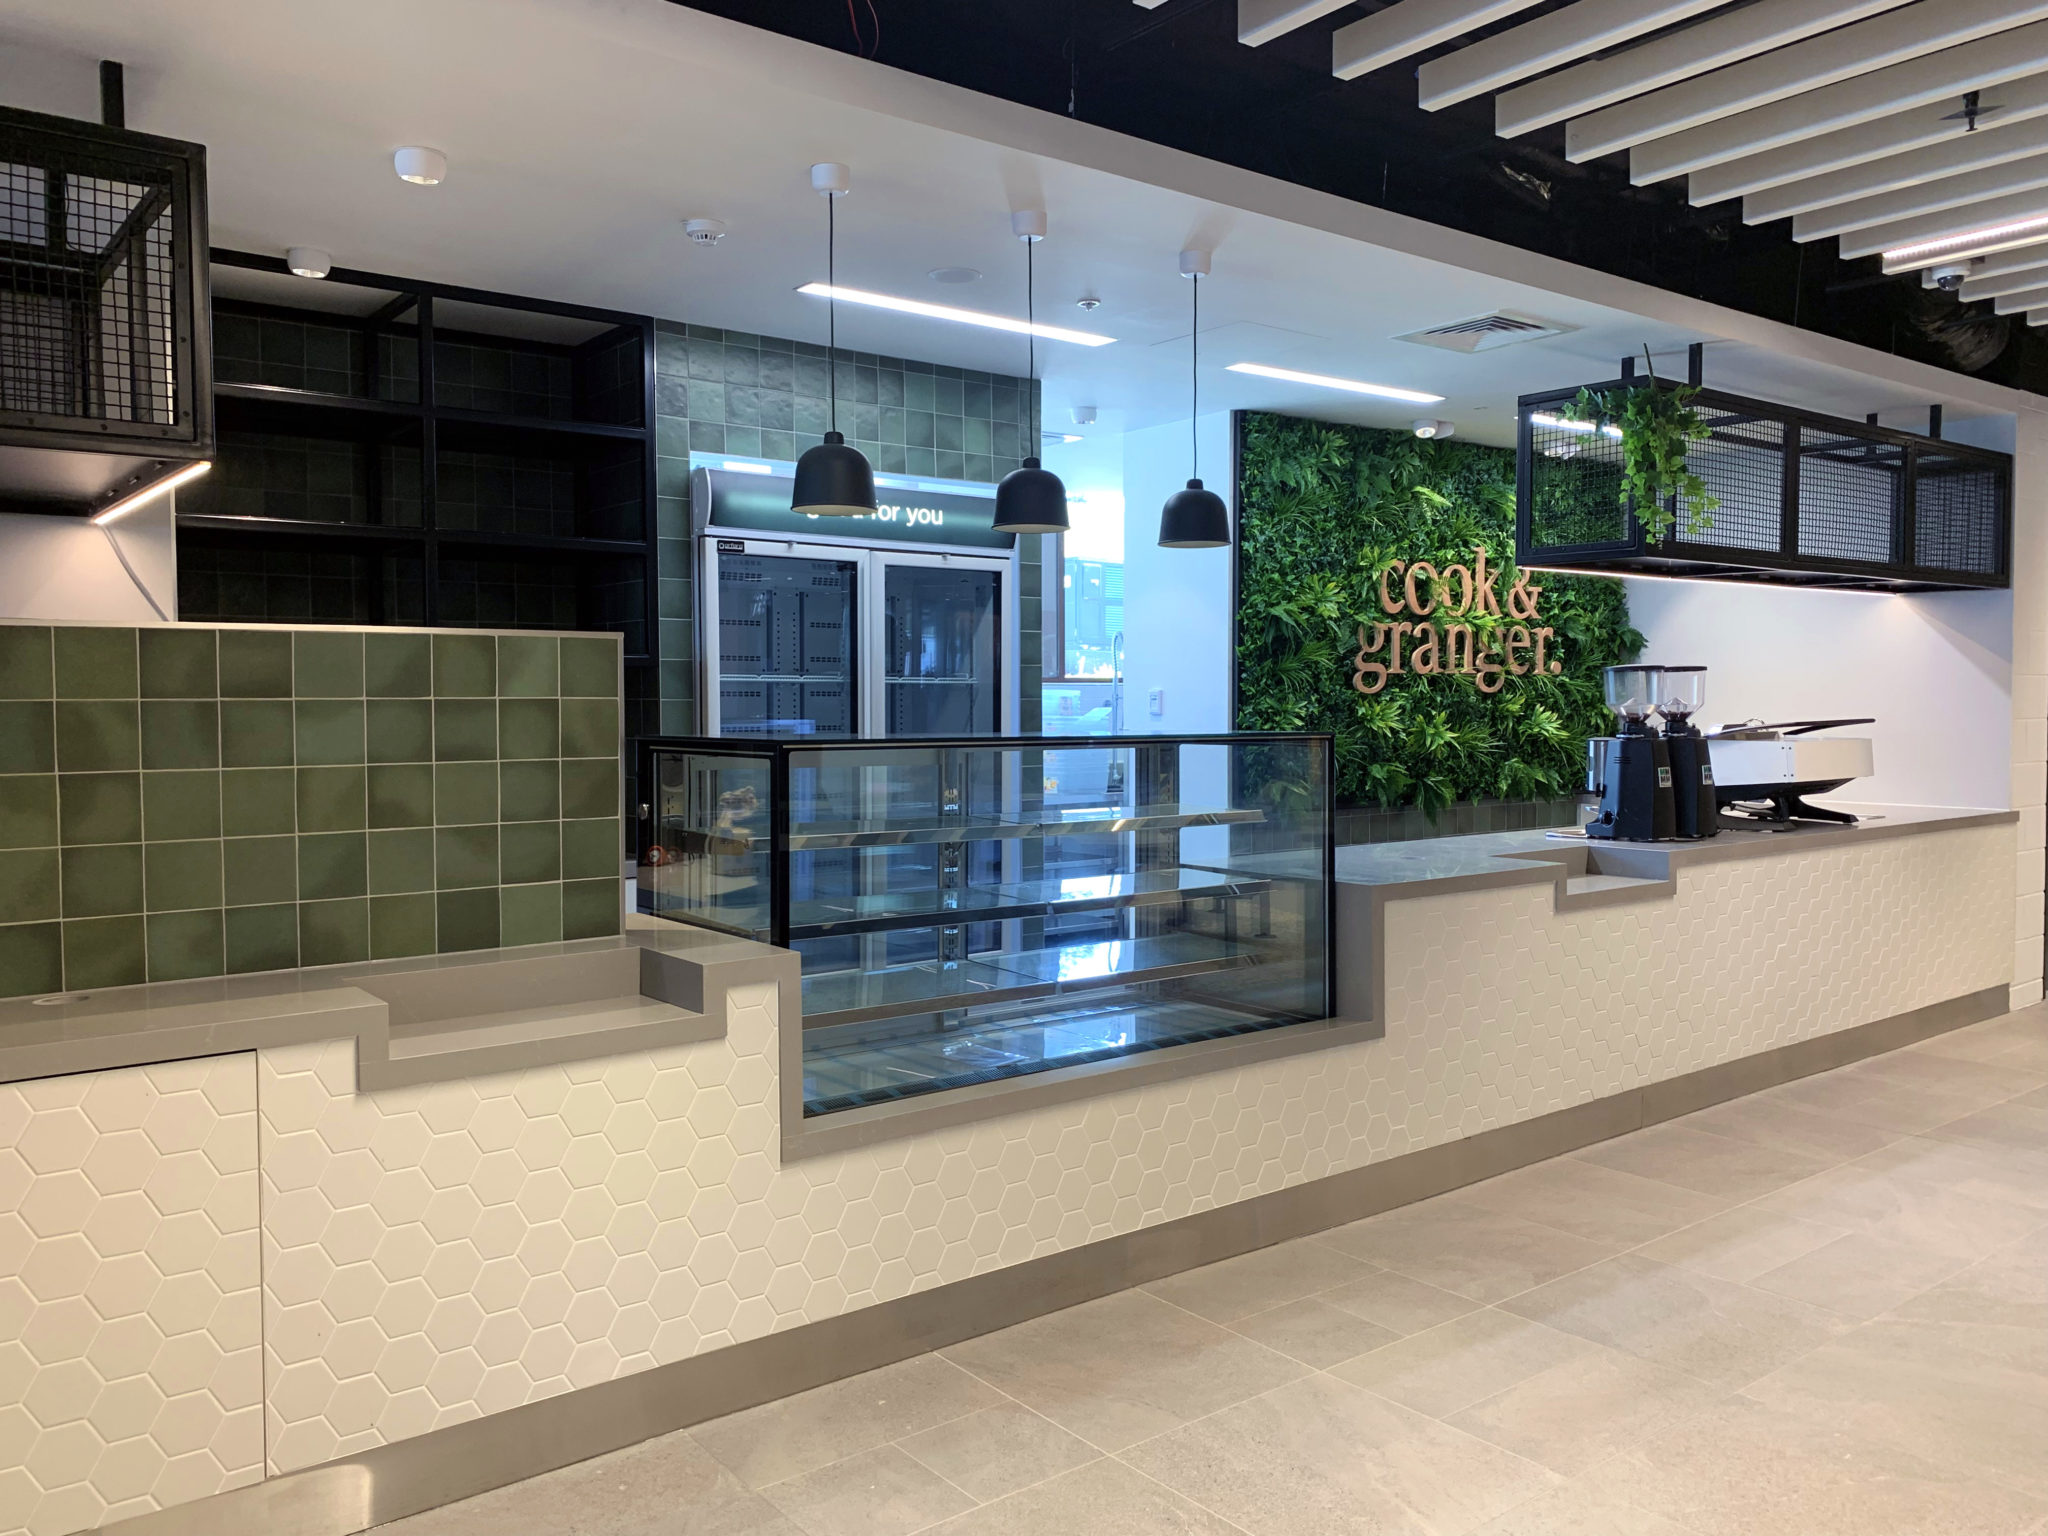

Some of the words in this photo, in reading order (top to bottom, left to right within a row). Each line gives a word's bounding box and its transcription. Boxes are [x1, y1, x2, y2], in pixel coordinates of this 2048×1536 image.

[906, 507, 944, 527] you
[1380, 546, 1503, 617] cook
[1508, 568, 1542, 619] &
[1353, 621, 1562, 694] granger.
